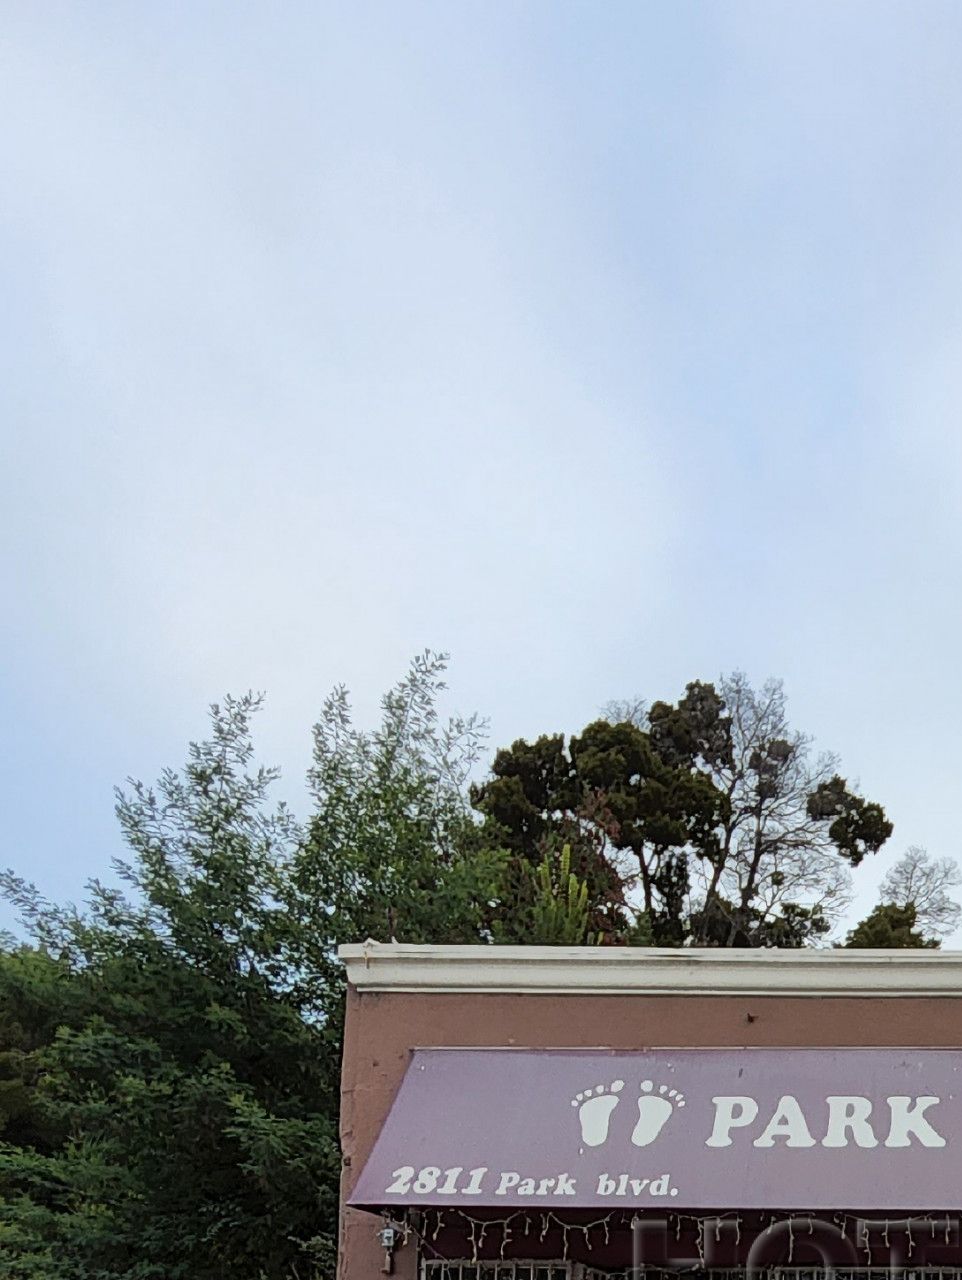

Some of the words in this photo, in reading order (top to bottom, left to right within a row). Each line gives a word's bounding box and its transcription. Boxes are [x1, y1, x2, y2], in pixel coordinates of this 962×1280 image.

[705, 1095, 946, 1148] PARK
[385, 1166, 489, 1195] 2811
[495, 1171, 577, 1197] Park
[596, 1172, 680, 1198] blvd.
